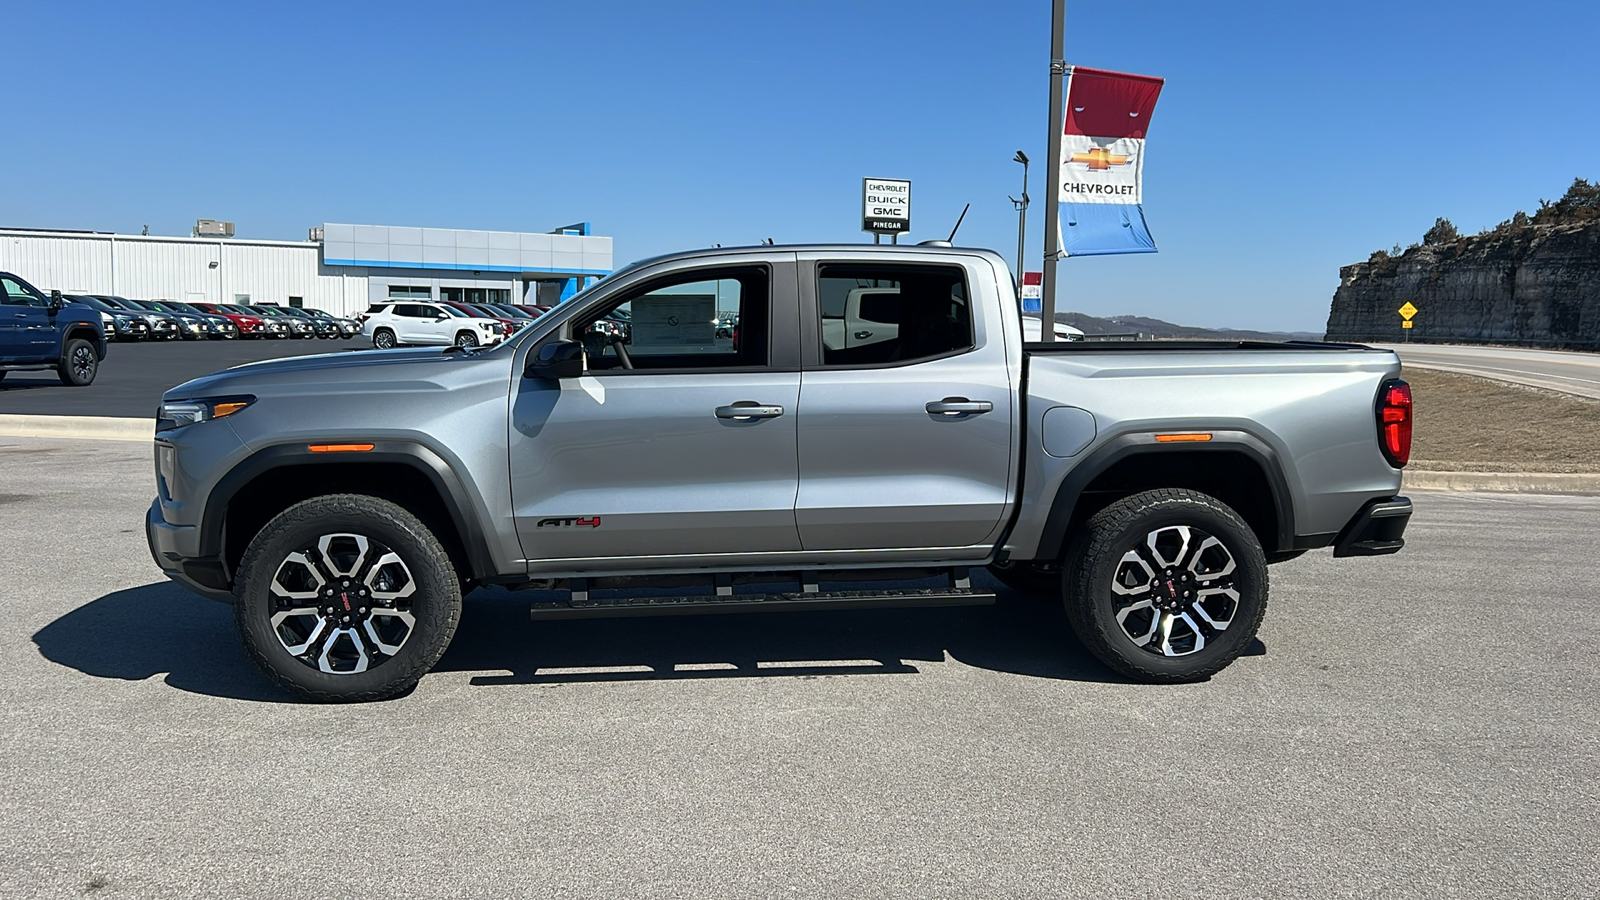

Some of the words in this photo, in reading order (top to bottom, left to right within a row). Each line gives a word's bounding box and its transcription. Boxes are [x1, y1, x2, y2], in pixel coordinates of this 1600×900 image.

[868, 184, 907, 193] CHEVROLET
[1063, 182, 1134, 195] CHEVROLET
[867, 195, 907, 205] BUICK
[873, 207, 902, 216] GMC
[873, 221, 901, 229] PINEGAR
[537, 516, 601, 528] AT4
[340, 591, 351, 611] GMC
